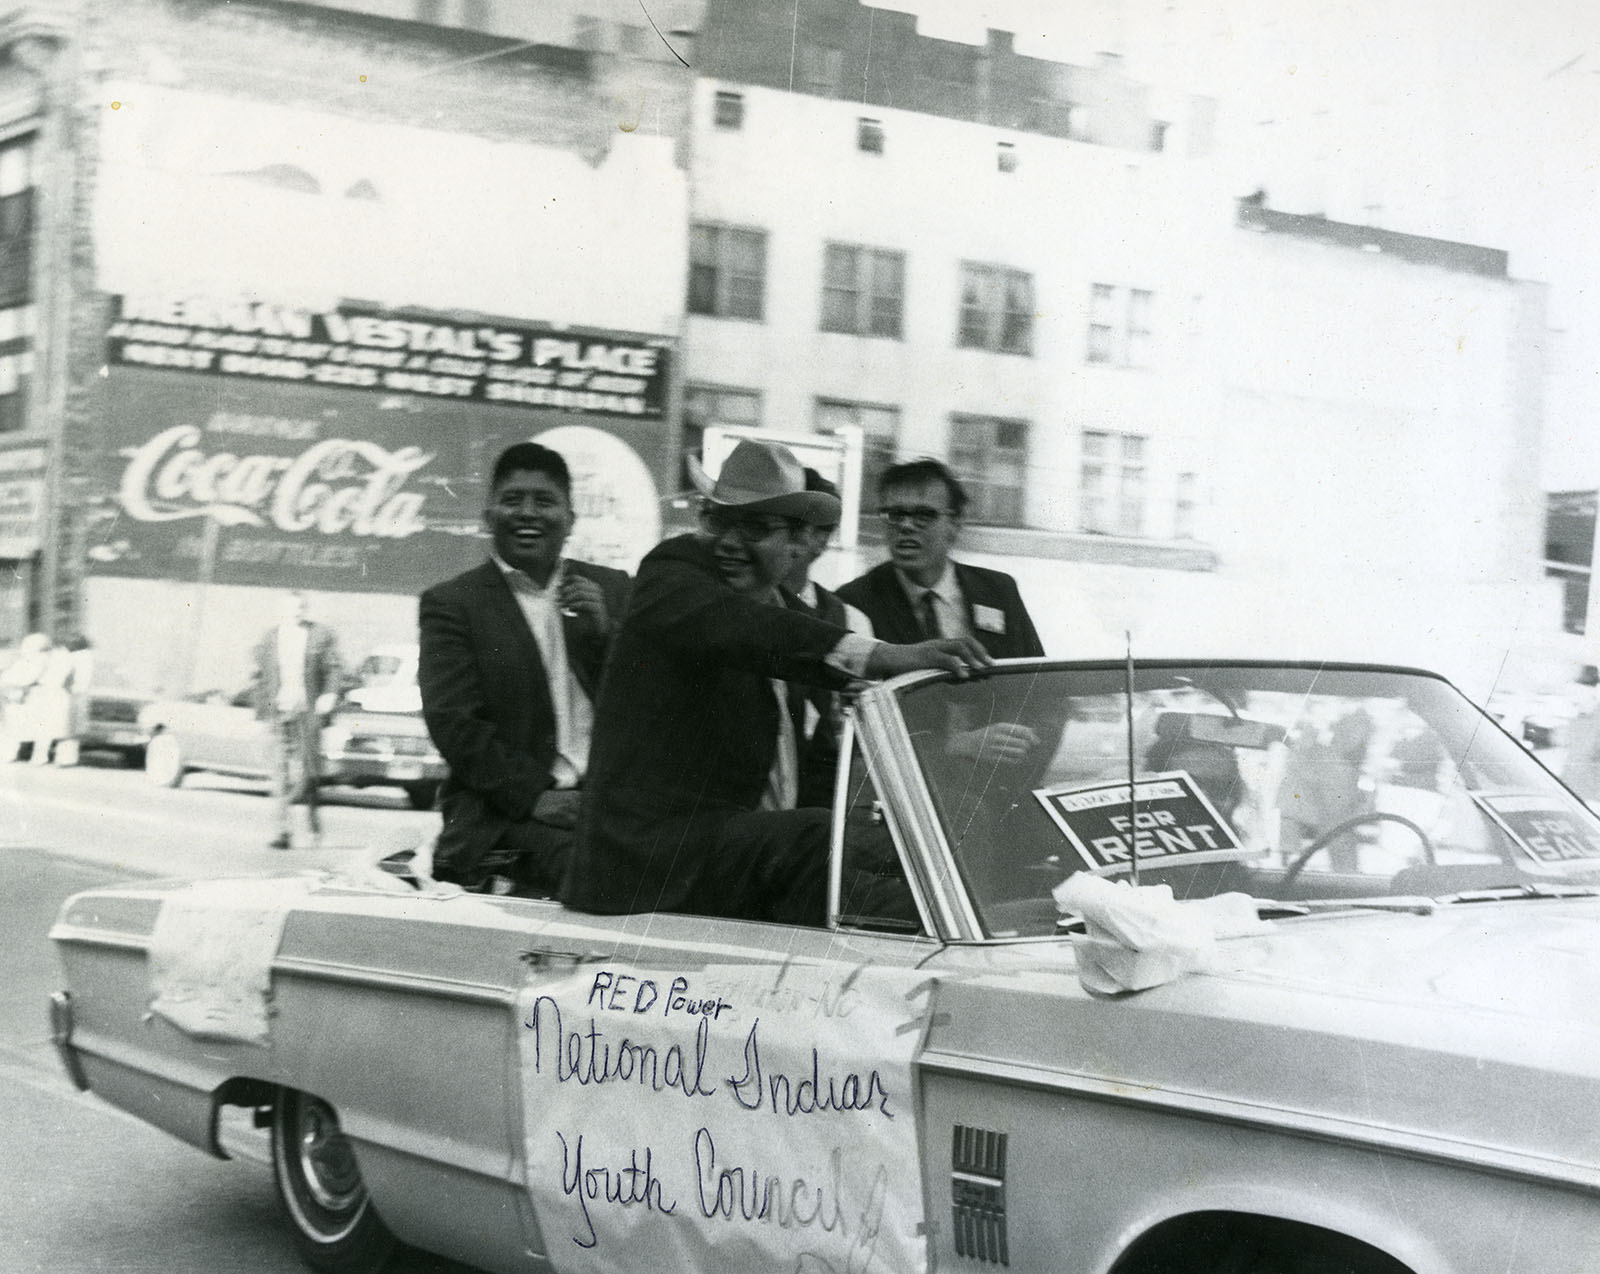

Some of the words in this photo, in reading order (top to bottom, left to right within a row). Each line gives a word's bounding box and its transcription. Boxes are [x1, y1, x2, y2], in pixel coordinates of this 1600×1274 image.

[532, 338, 658, 376] PLACE
[1108, 809, 1177, 832] FOR
[1090, 824, 1219, 863] RENT
[587, 971, 659, 1015] RED
[664, 976, 733, 1020] Power
[524, 995, 717, 1098] National
[726, 1017, 895, 1118] Indian
[556, 1130, 677, 1249] Youth
[695, 1127, 848, 1236] Council
